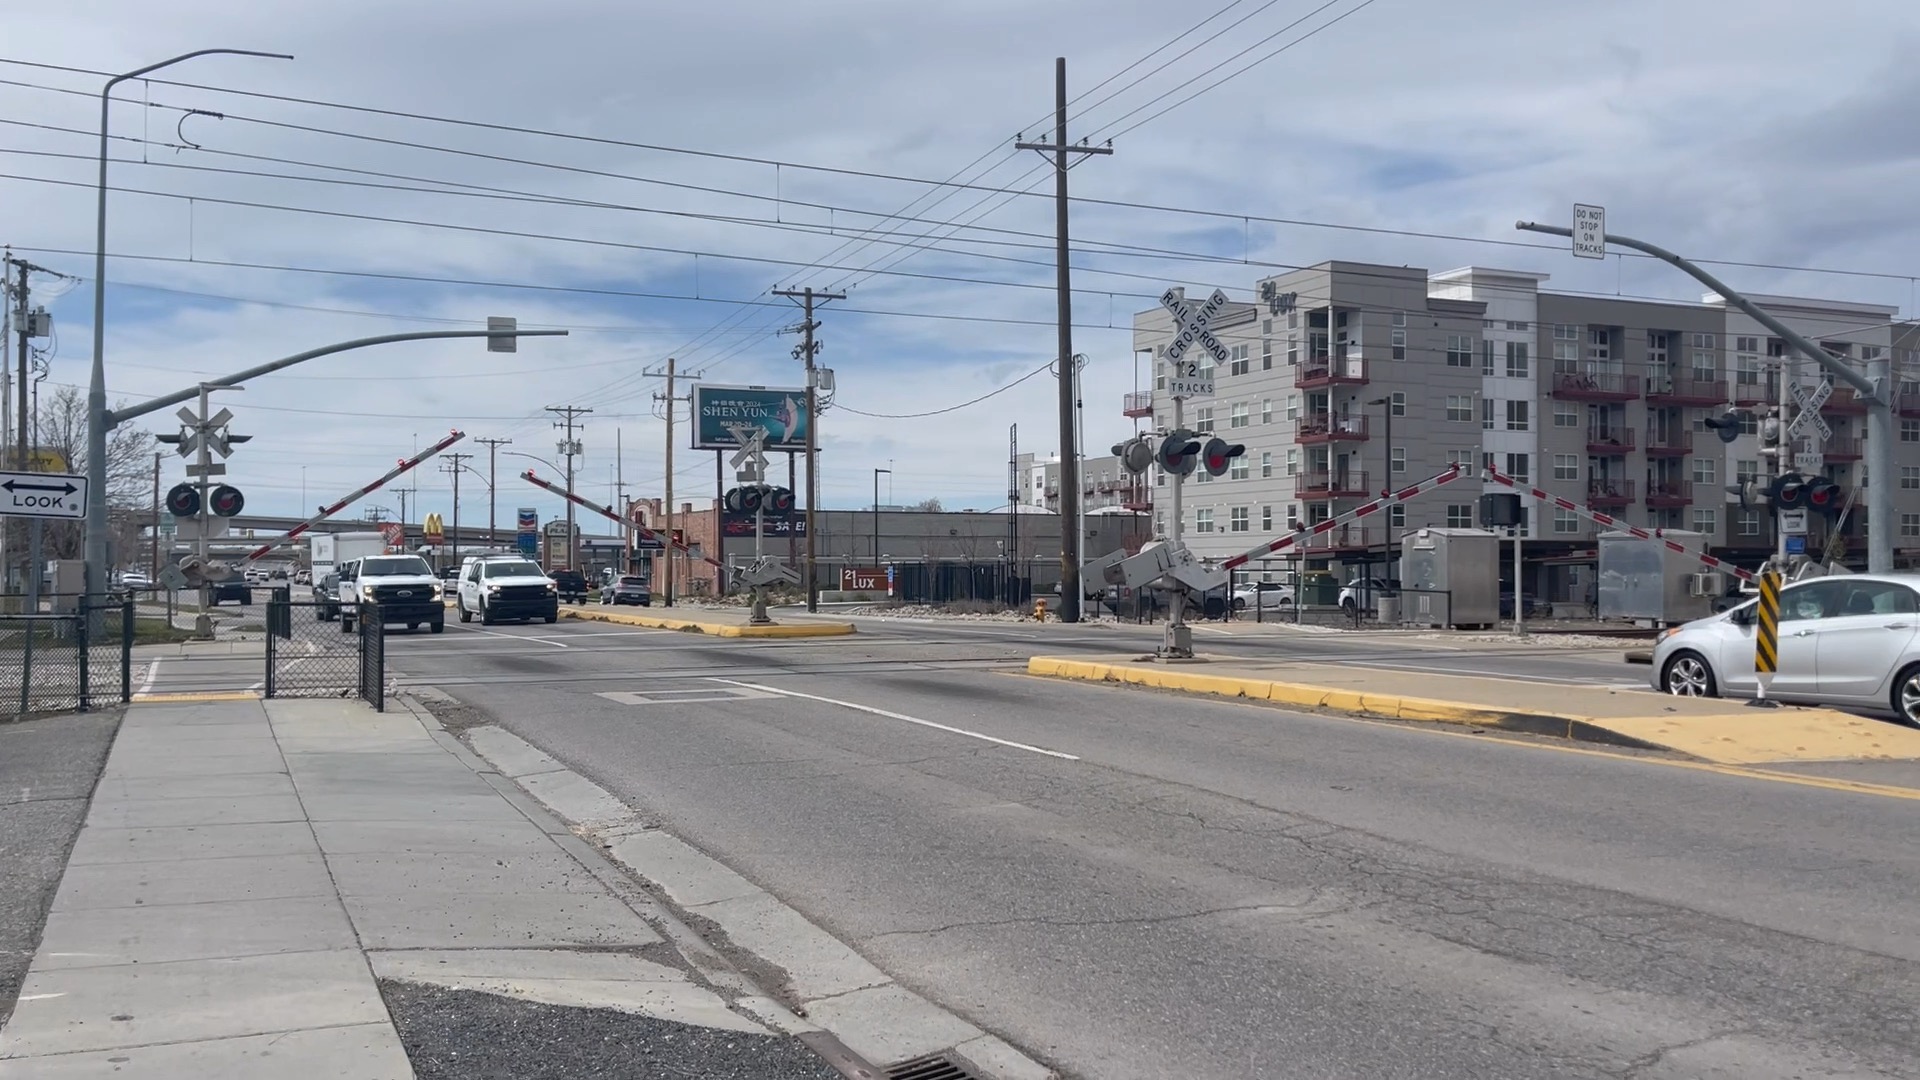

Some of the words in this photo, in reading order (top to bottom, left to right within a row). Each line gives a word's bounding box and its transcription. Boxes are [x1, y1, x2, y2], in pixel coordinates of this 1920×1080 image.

[1576, 209, 1586, 218] DO
[1589, 211, 1602, 220] NOT
[1580, 221, 1598, 230] STOP
[1584, 233, 1594, 241] ON
[1576, 243, 1602, 254] TRACKS
[1163, 292, 1188, 322] RAIL
[1199, 331, 1227, 361] ROAD
[1169, 294, 1224, 359] CROSSING
[1188, 364, 1196, 377] 2
[1171, 382, 1213, 393] TRACKS
[703, 406, 738, 417] SHEN
[742, 407, 768, 418] YUN
[1789, 381, 1806, 406] RAIL
[1812, 414, 1830, 440] ROAD
[1792, 385, 1830, 436] CROSSING
[1806, 443, 1813, 454] 2
[13, 495, 63, 508] LOOK
[775, 521, 806, 531] SAE!
[844, 569, 856, 580] 21
[853, 578, 875, 589] LUX
